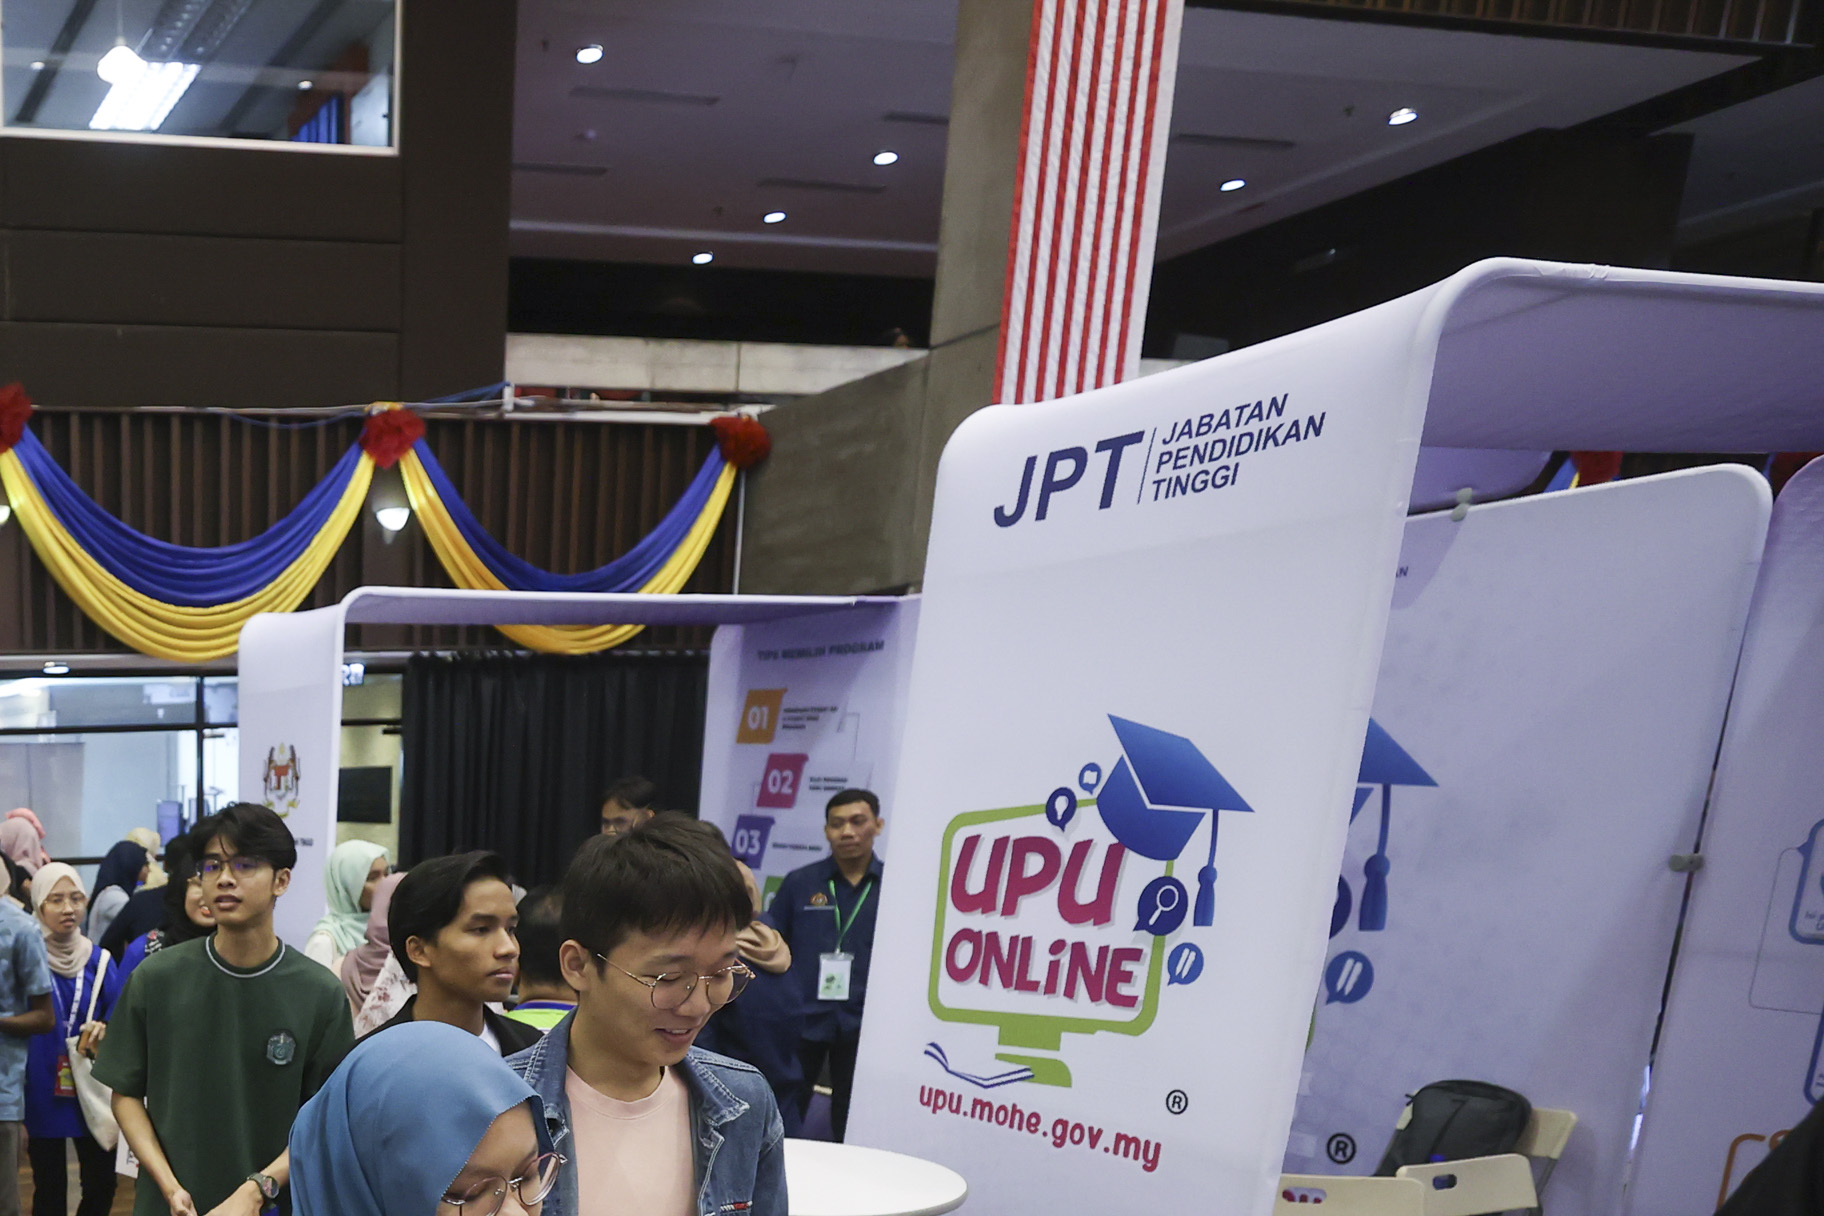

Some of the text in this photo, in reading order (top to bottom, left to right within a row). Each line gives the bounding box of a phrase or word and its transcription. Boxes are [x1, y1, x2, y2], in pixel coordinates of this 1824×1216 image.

[1156, 411, 1326, 474] PENDIDIKAN
[1162, 393, 1288, 445] JABATAN
[993, 430, 1145, 527] JPT
[1152, 462, 1239, 501] TINGGI
[747, 706, 769, 730] 01
[768, 769, 793, 795] 02
[736, 828, 761, 855] 03
[950, 834, 1127, 926] UPU
[919, 1085, 1162, 1172] upu.mohe.gov.my
